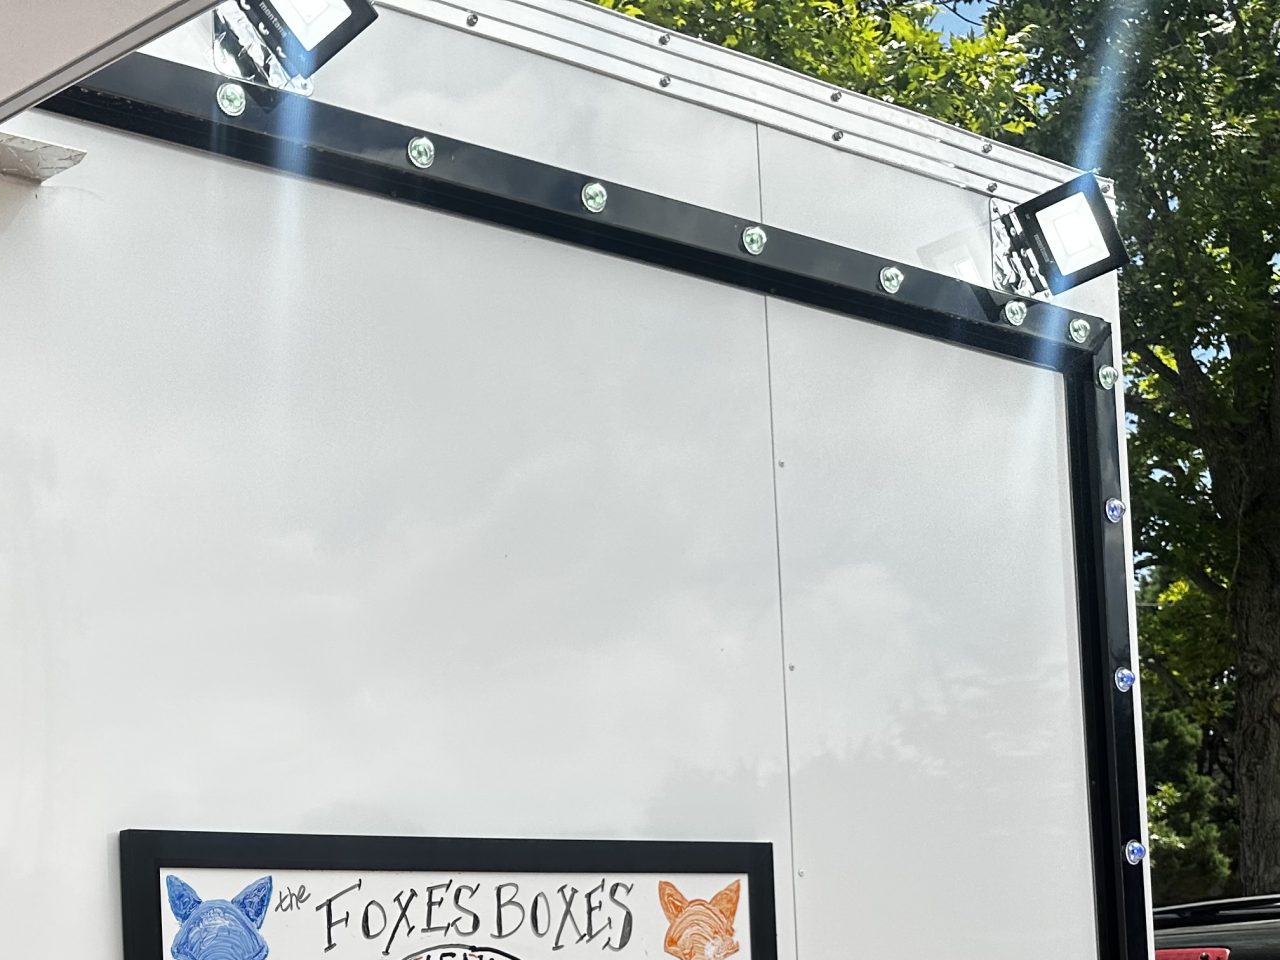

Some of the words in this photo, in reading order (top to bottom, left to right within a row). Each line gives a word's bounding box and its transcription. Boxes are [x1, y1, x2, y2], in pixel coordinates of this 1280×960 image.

[275, 884, 311, 912] the
[316, 878, 480, 955] FOXES
[490, 878, 634, 951] BOXES
